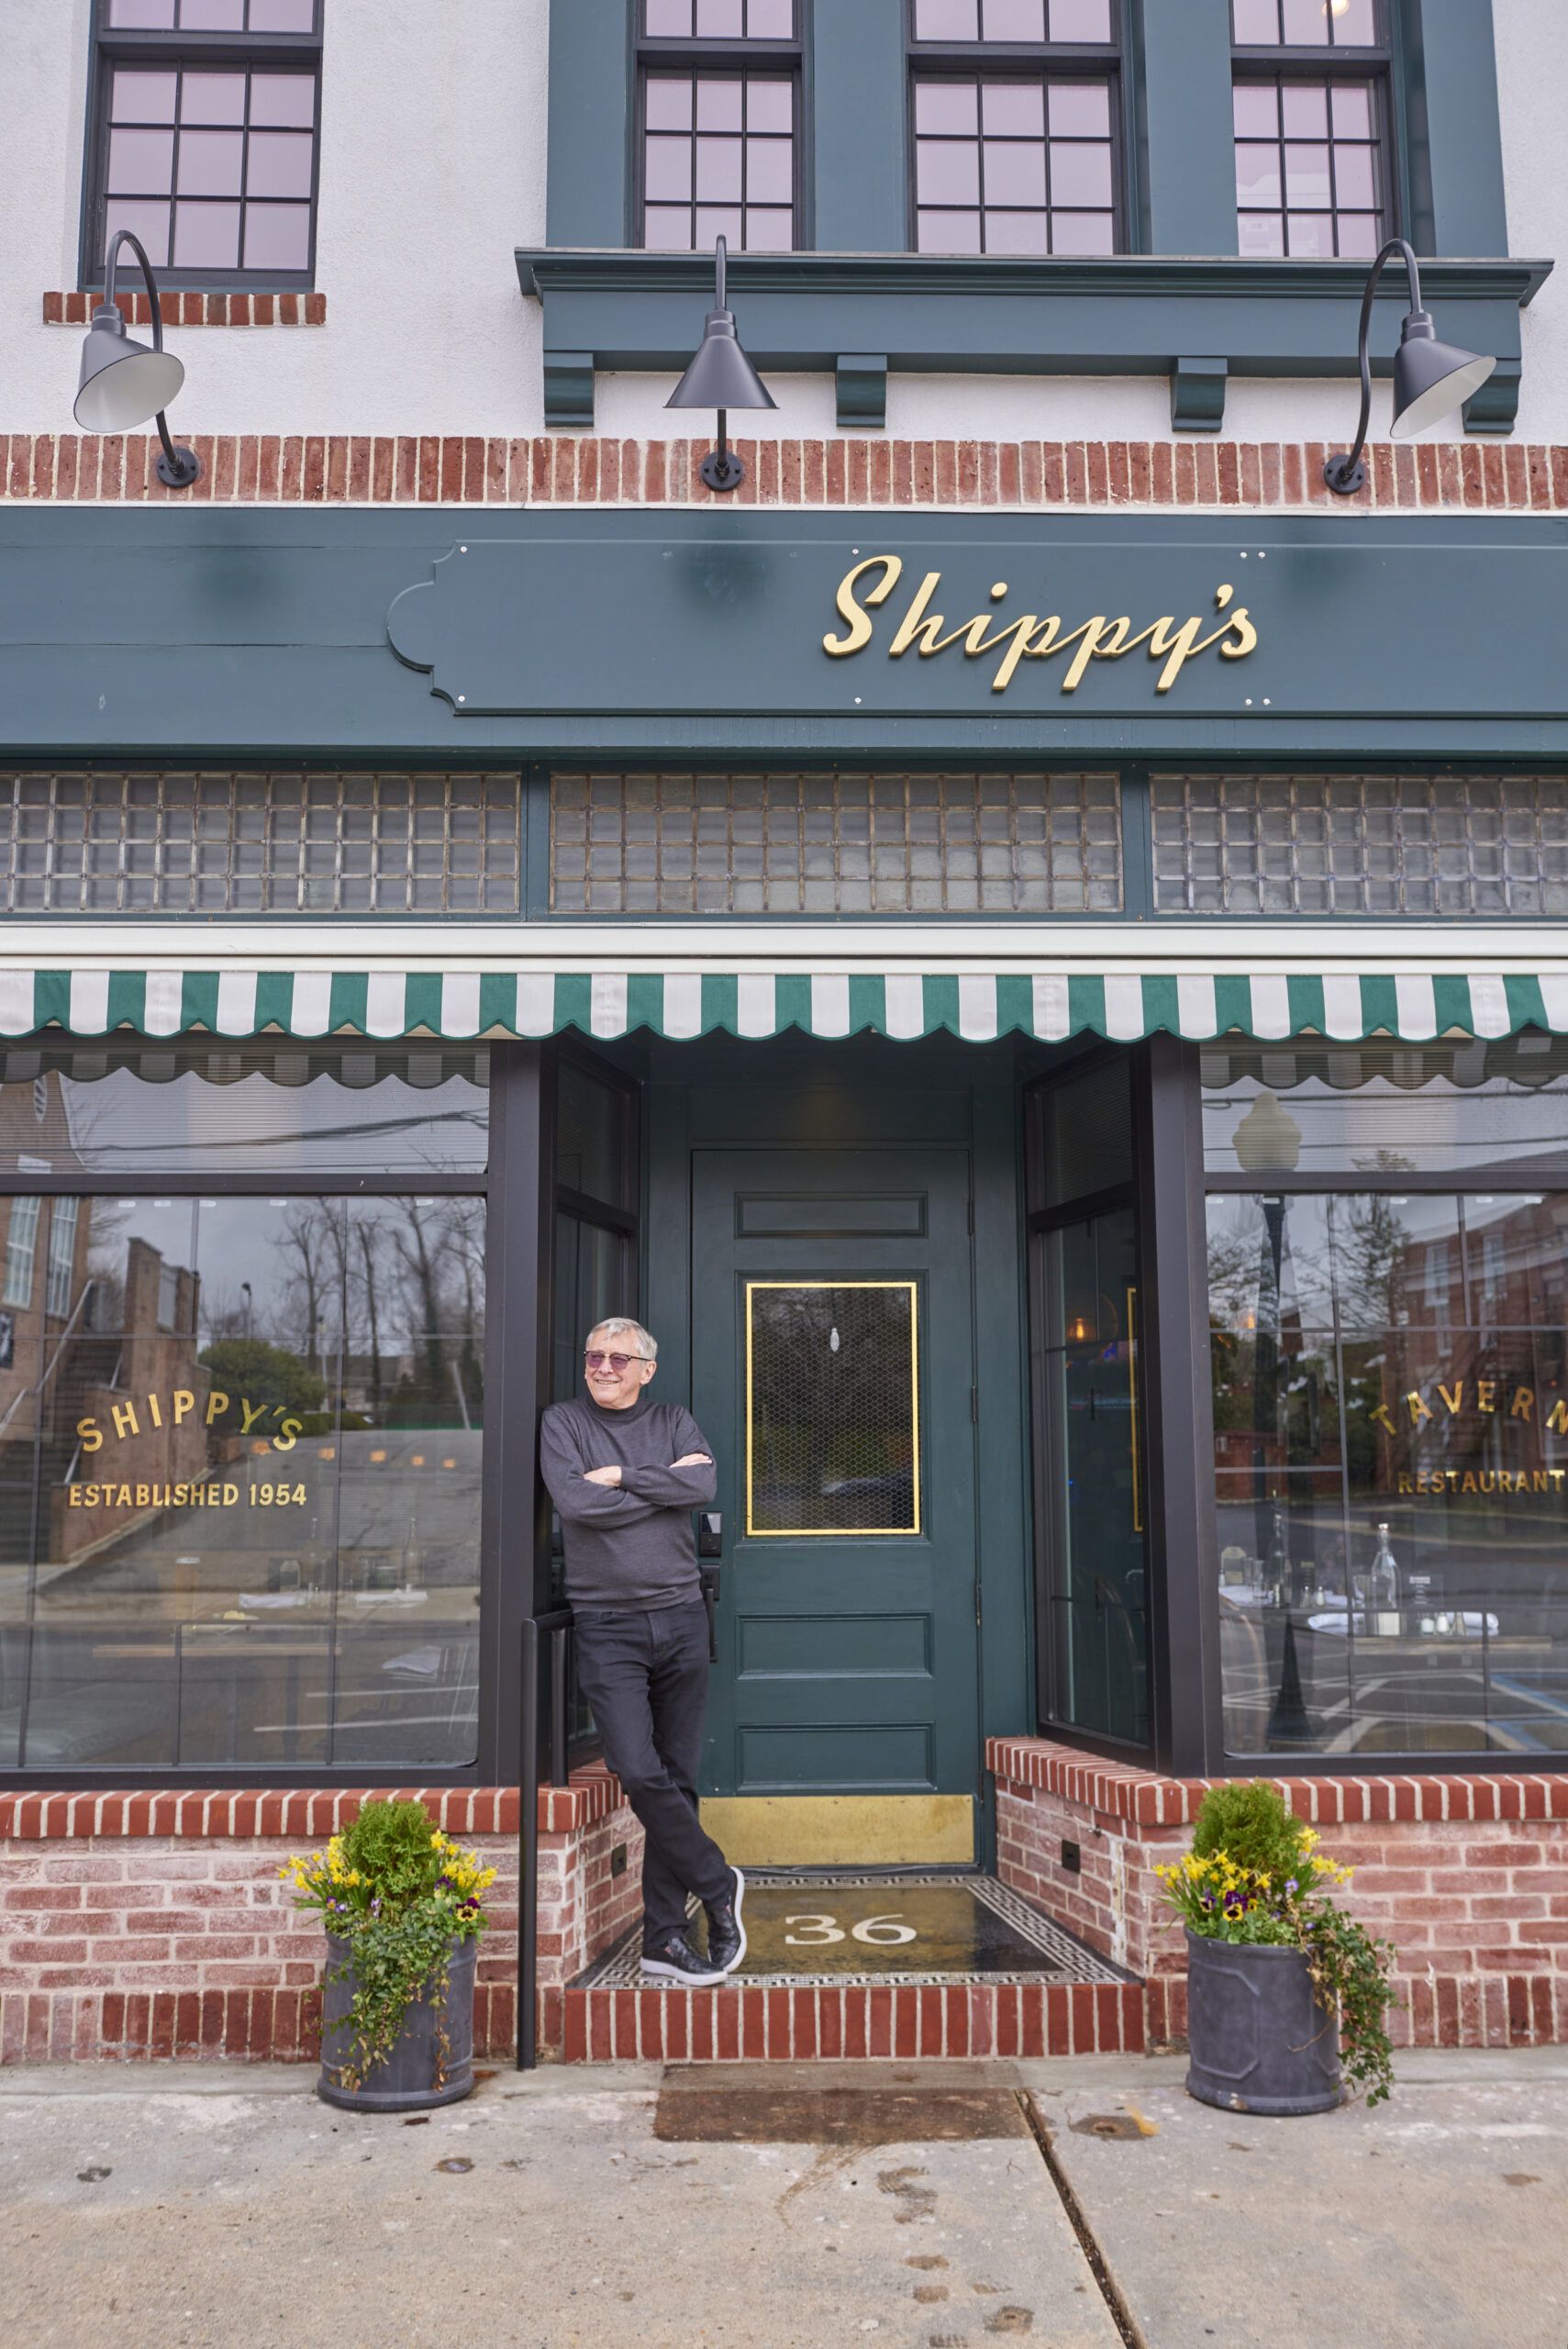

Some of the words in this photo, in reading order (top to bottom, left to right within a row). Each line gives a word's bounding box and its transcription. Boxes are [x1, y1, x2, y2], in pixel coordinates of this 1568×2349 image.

[823, 555, 1257, 691] Shippy's
[77, 1390, 304, 1452] SHIPPY'S
[69, 1483, 239, 1508] ESTABLISHED
[250, 1483, 307, 1507] 1954
[1398, 1470, 1565, 1494] RESTAURANT
[784, 1913, 917, 1945] 36
